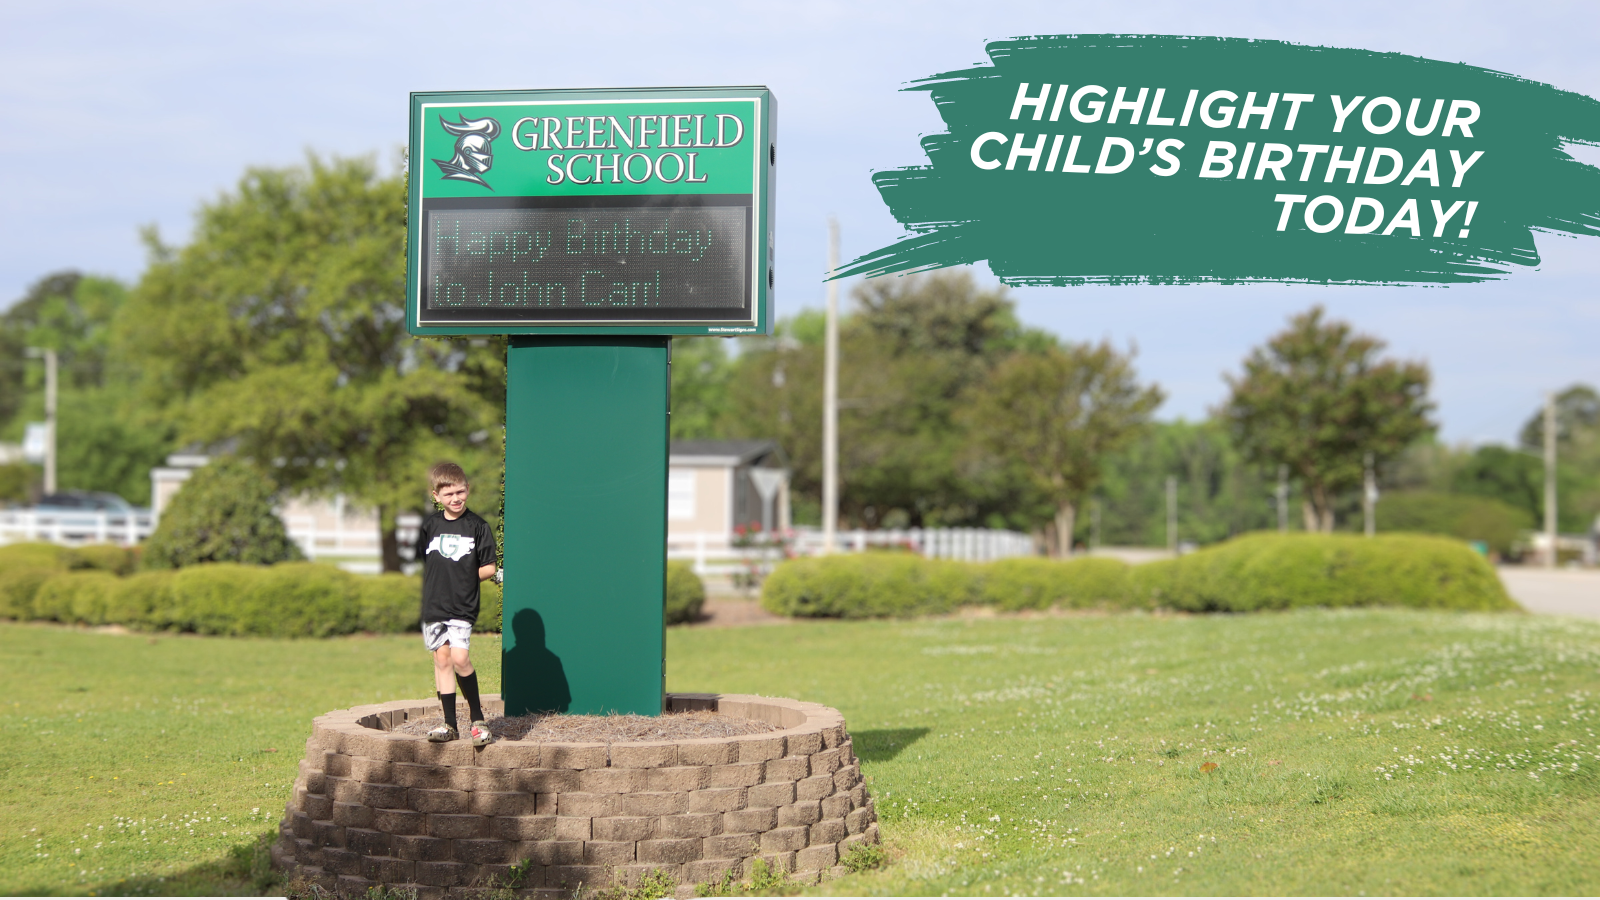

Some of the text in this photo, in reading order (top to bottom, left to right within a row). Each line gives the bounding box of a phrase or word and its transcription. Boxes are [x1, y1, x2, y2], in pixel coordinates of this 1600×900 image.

[511, 113, 745, 151] GREENFIELD
[546, 152, 708, 185] SCHOOL
[436, 218, 712, 263] Happy Birthday
[435, 275, 466, 306] to
[477, 270, 567, 306] John
